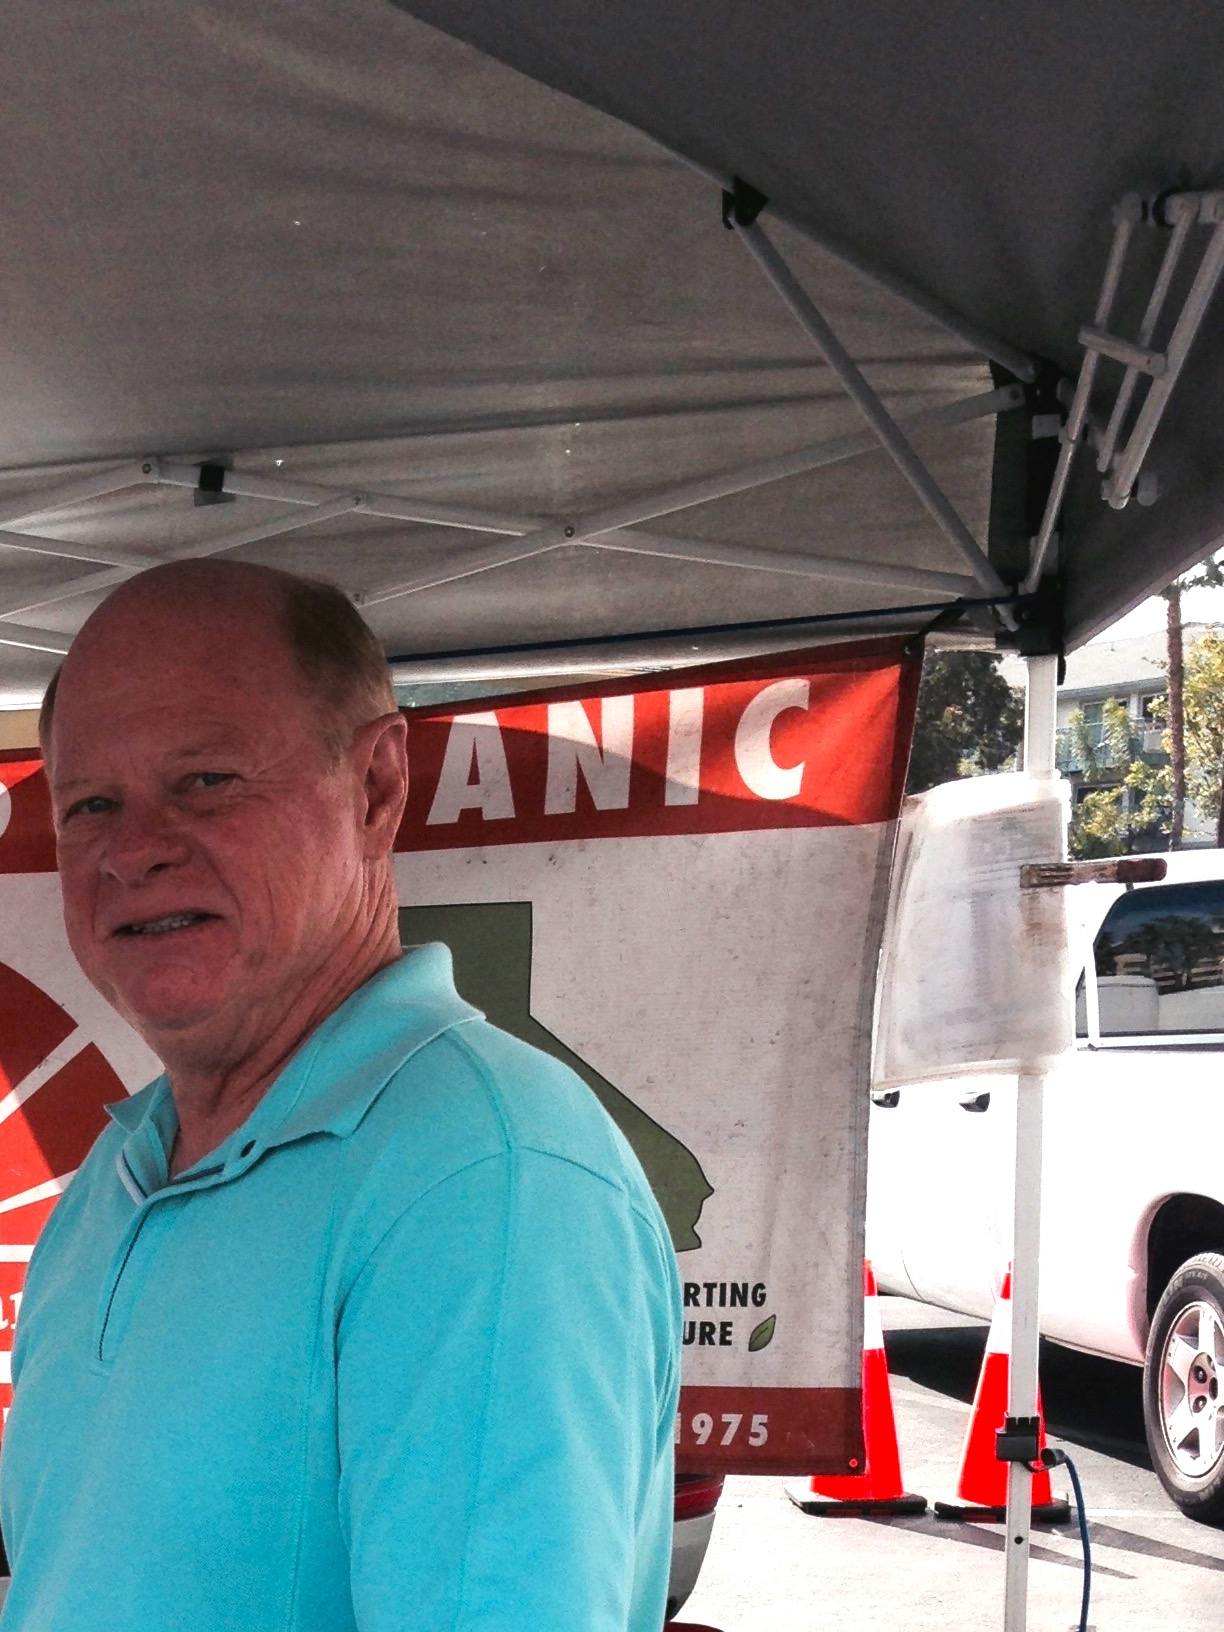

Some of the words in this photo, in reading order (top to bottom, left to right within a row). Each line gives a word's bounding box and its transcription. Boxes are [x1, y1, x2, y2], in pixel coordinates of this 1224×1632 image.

[425, 678, 811, 826] ANIC
[683, 1282, 767, 1308] RTING
[682, 1320, 733, 1346] URE
